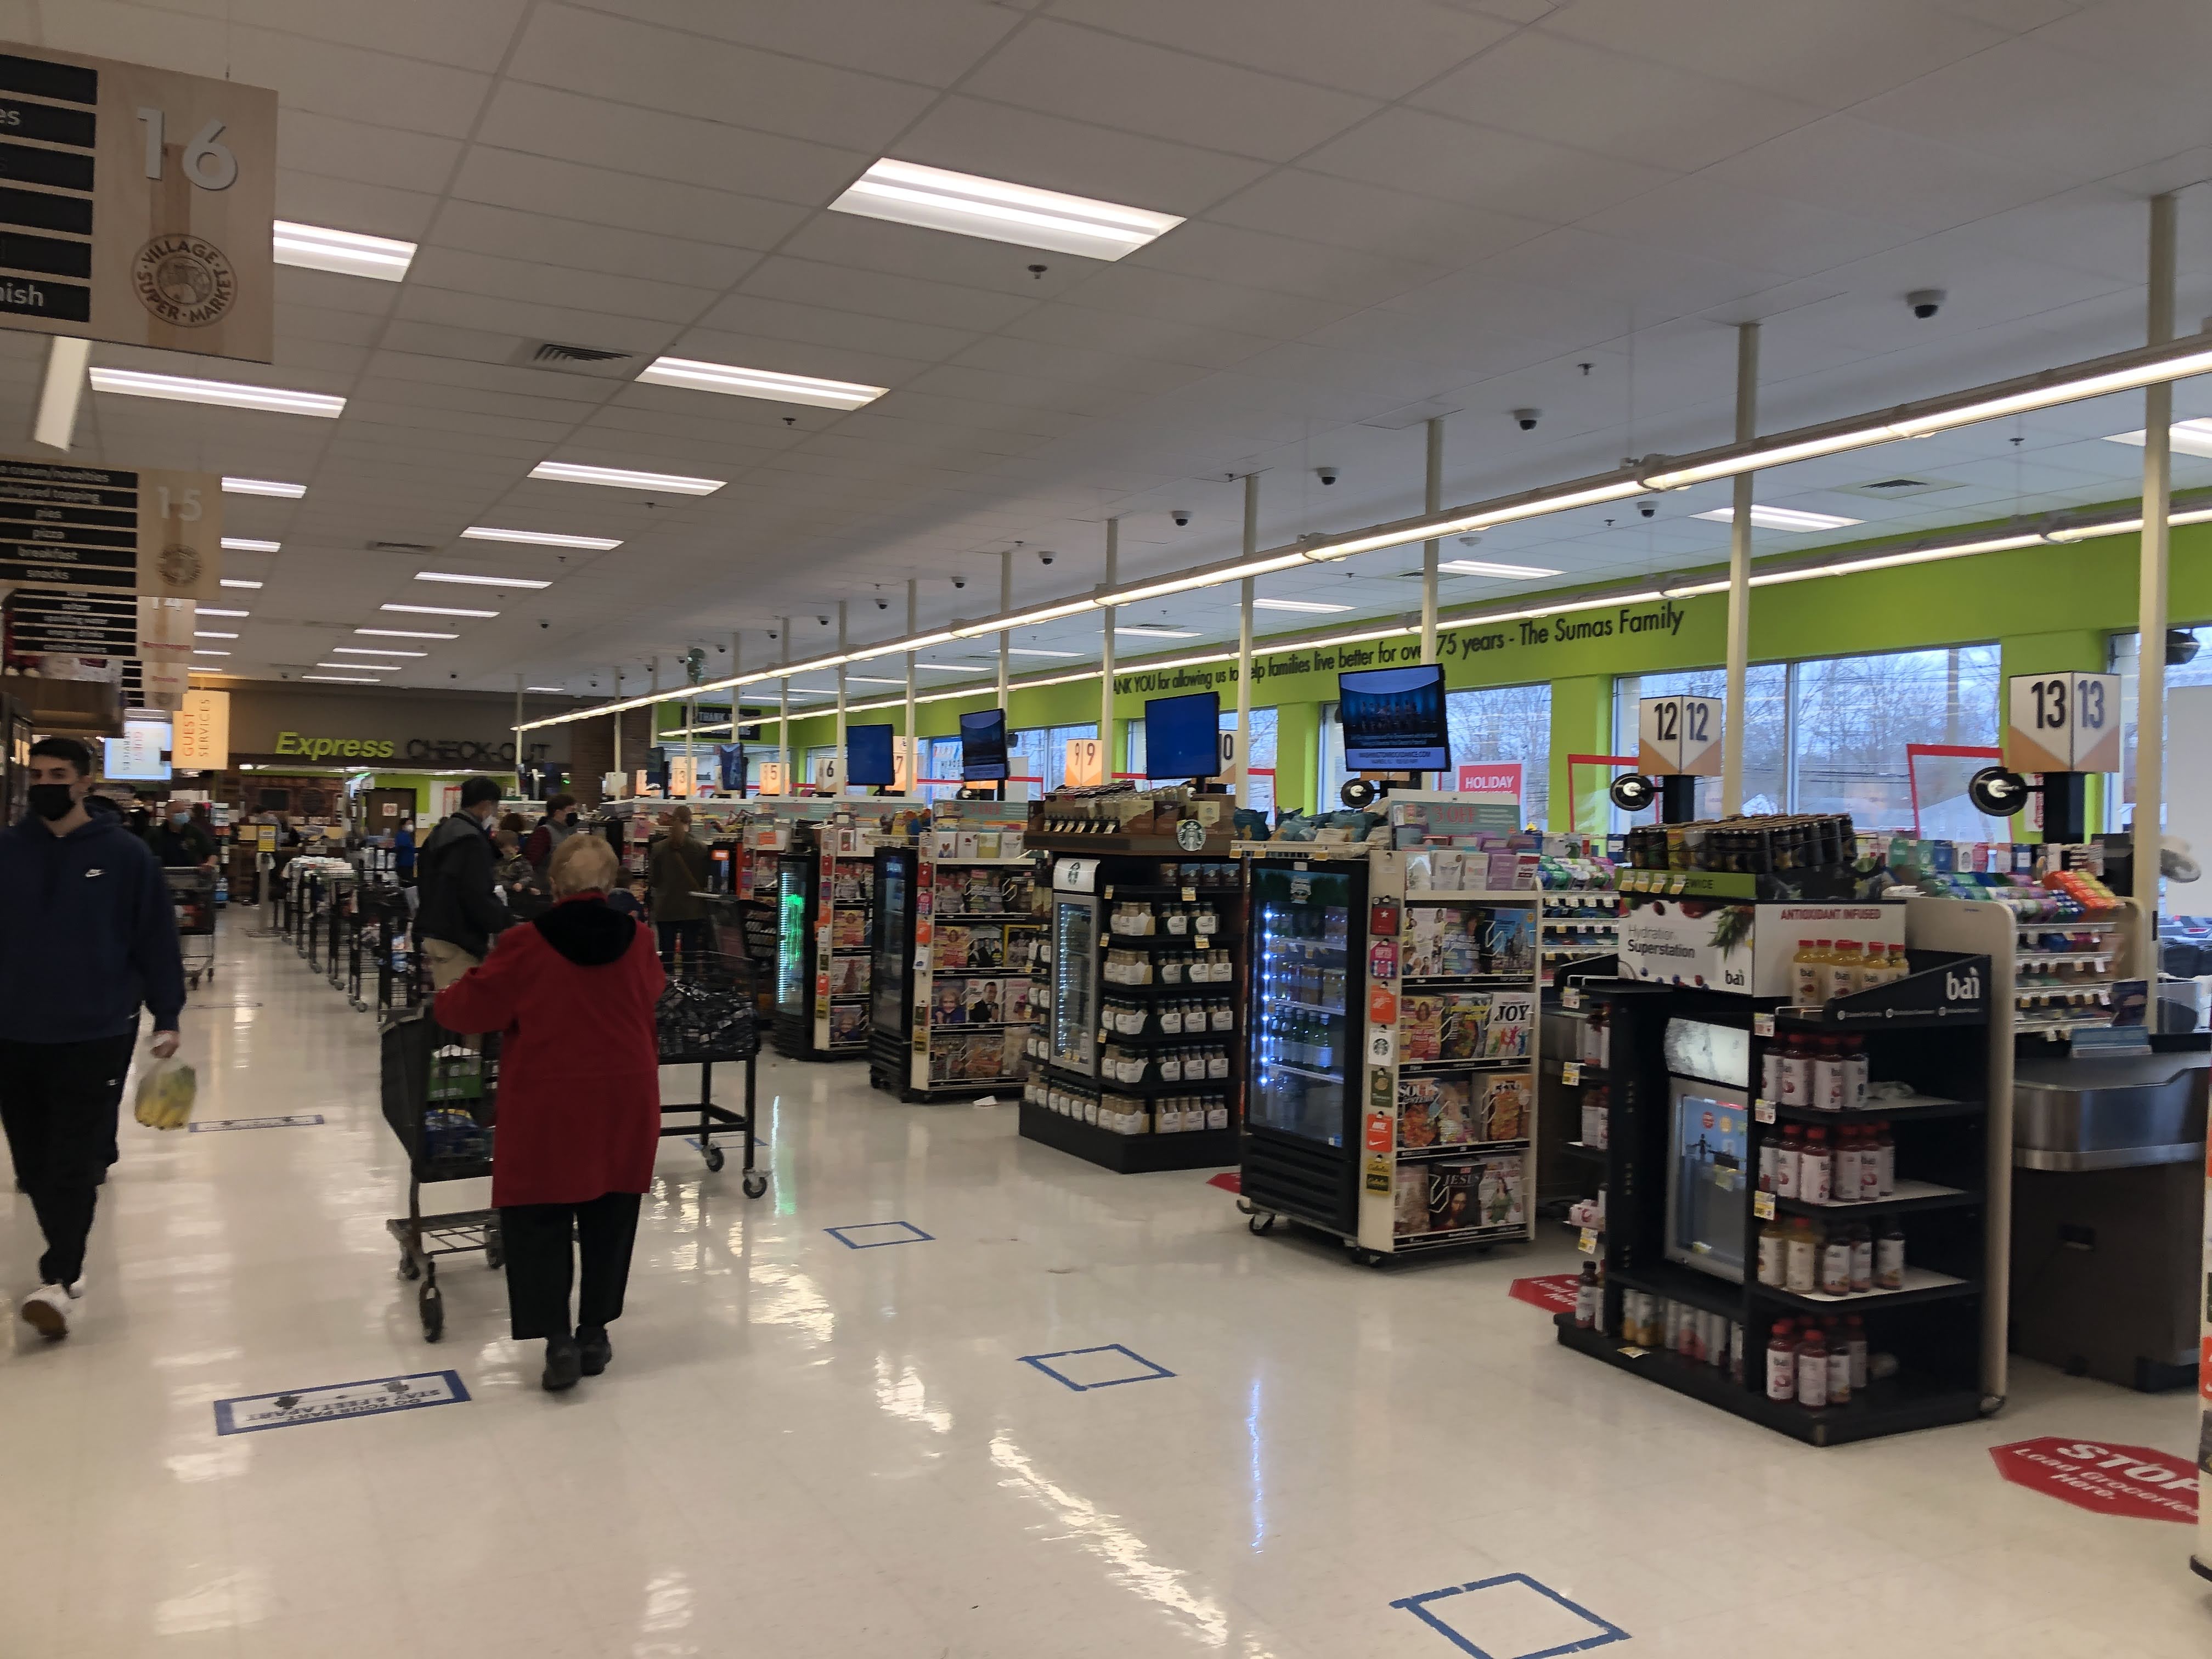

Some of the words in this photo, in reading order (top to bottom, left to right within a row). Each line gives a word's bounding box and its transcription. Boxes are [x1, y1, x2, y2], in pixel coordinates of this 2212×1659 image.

[137, 107, 238, 190] 16
[142, 240, 218, 266] VILLAGE
[137, 270, 179, 320] SUPER
[189, 270, 231, 323] MARKET
[158, 486, 202, 522] 15
[1135, 674, 1155, 692] YOU
[1158, 672, 1170, 690] for
[1172, 669, 1212, 690] allowing
[1215, 670, 1226, 683] us
[1229, 667, 1239, 681] to
[1250, 658, 1265, 684] elp
[1269, 654, 1311, 676] families
[1314, 651, 1335, 671] live
[1339, 647, 1374, 668] better
[1378, 641, 1396, 663] for
[1401, 645, 1422, 661] ove
[1436, 633, 1456, 656] 75
[1463, 634, 1504, 659] years
[1520, 620, 1549, 646] The
[1555, 618, 1612, 642] Sumas
[1620, 602, 1685, 635] Family
[1654, 702, 1678, 741] 12
[1686, 702, 1708, 741] 12
[2030, 680, 2066, 730] 13
[2078, 680, 2104, 729] 13
[184, 714, 195, 757] GUEST
[276, 732, 394, 761] Express
[1087, 742, 1095, 766] 9
[826, 760, 834, 777] 6
[1465, 776, 1514, 789] HOLIDAY
[1627, 939, 1696, 958] Superstation
[1946, 967, 1980, 1000] bai
[1494, 1005, 1531, 1022] JOY
[2012, 1448, 2080, 1471] Load
[2056, 1444, 2199, 1492] STOP
